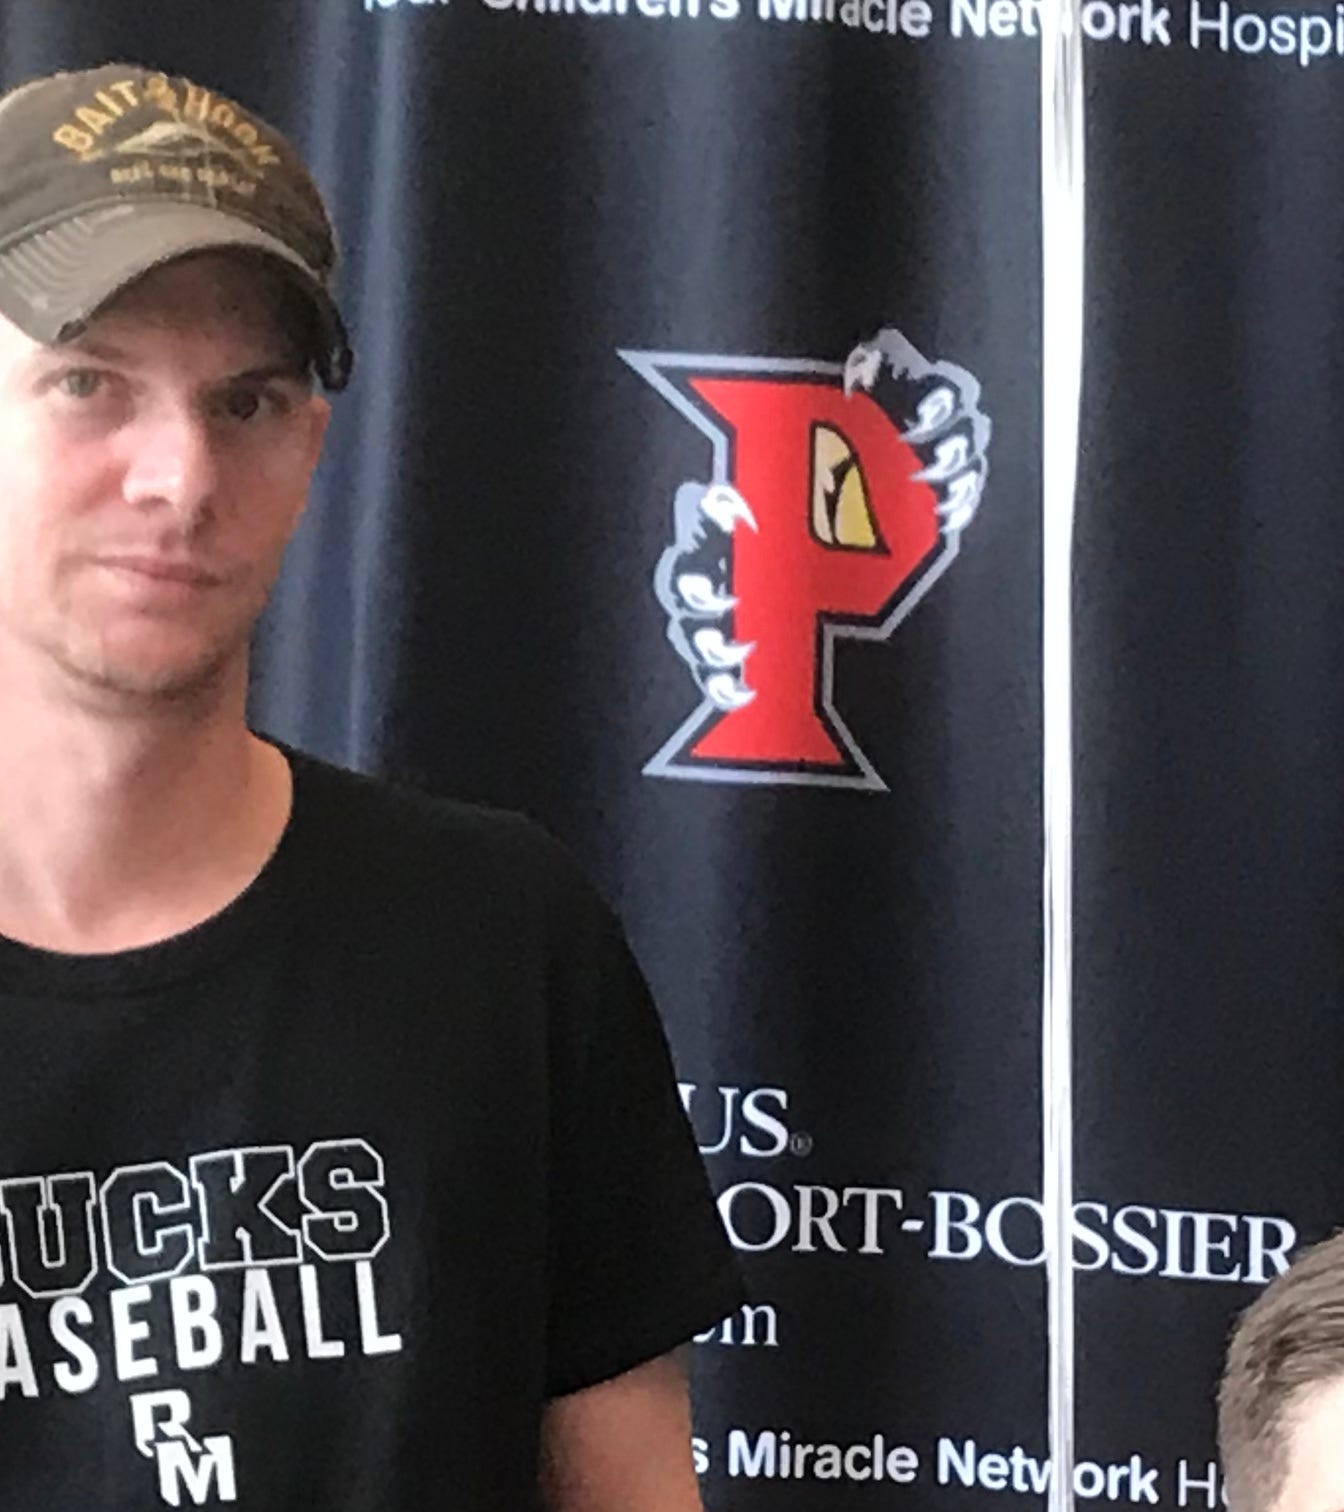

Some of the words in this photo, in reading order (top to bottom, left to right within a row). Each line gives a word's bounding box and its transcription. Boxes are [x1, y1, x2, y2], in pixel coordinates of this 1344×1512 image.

[950, 0, 1172, 47] Netork
[52, 79, 139, 155] BAIT
[727, 1429, 919, 1484] Miracle
